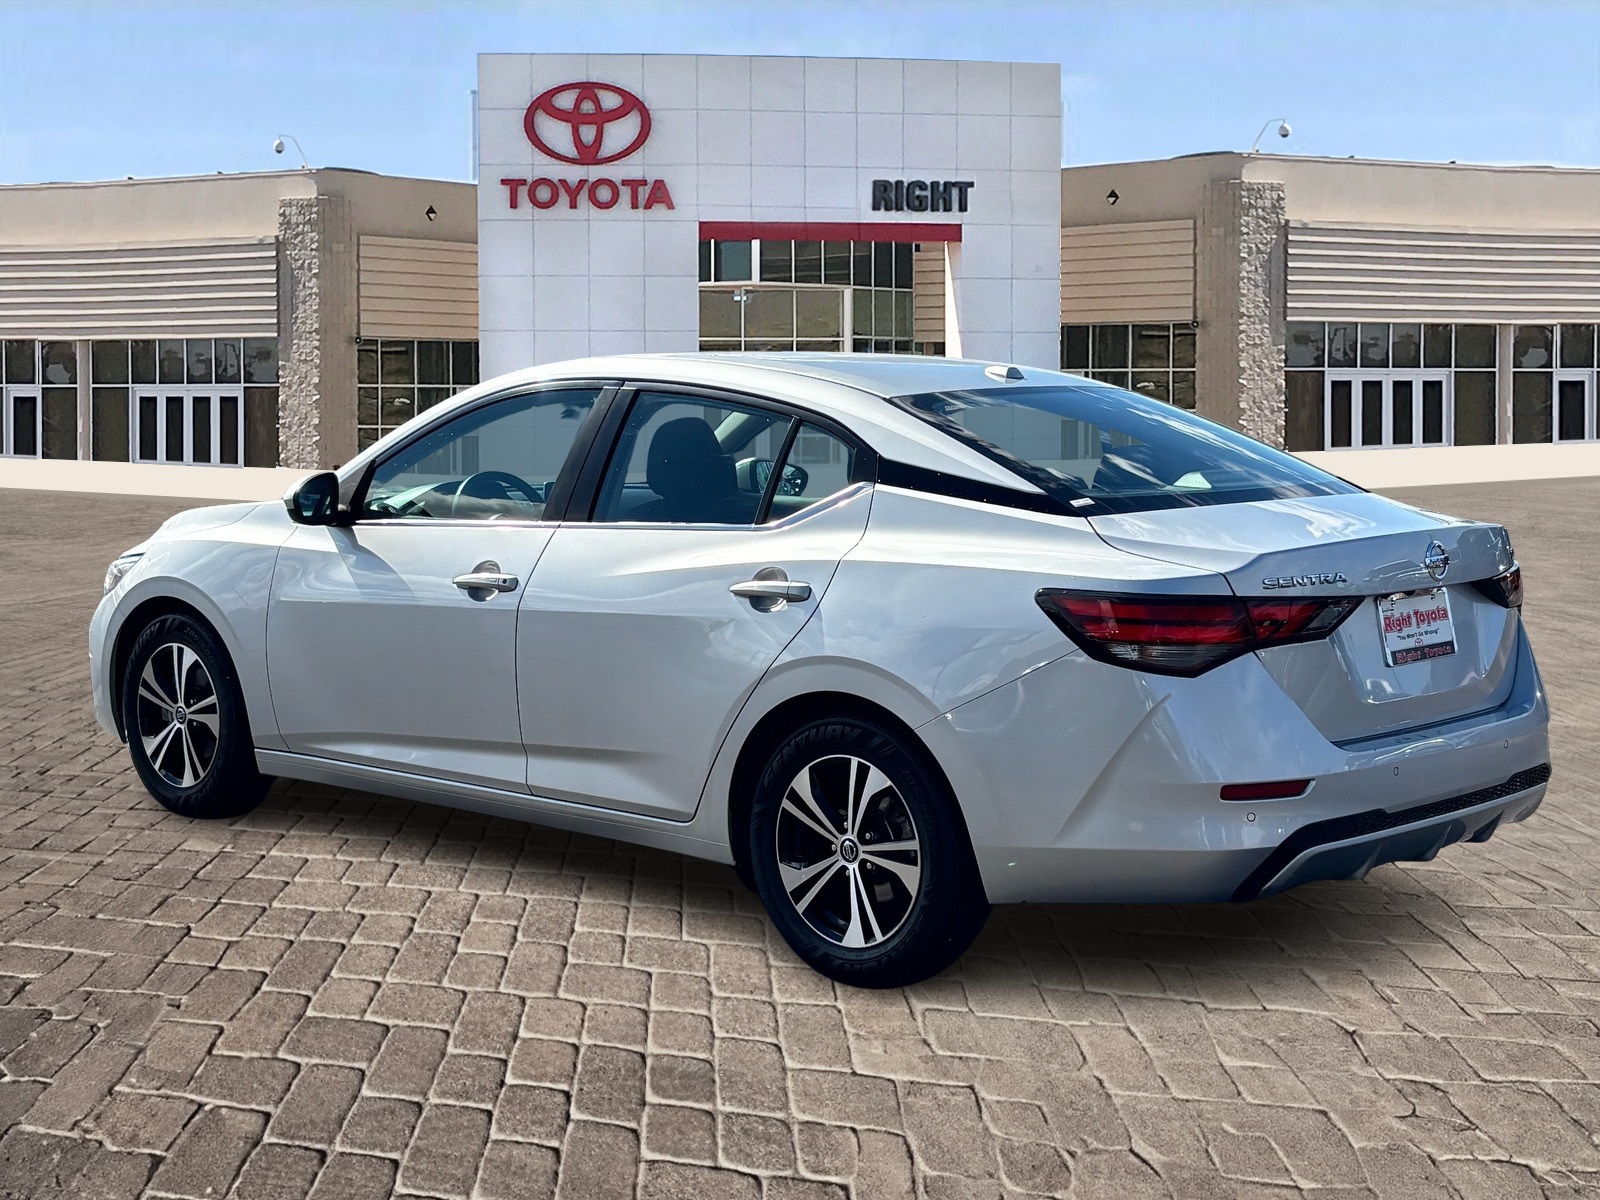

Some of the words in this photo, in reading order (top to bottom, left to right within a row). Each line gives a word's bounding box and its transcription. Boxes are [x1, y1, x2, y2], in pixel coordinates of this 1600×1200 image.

[500, 177, 675, 210] TOYOTA
[872, 179, 975, 212] RIGHT
[1262, 572, 1348, 590] SENTRA
[1384, 612, 1412, 633] Right
[1413, 606, 1449, 628] Toyota
[1424, 646, 1451, 658] Toyota
